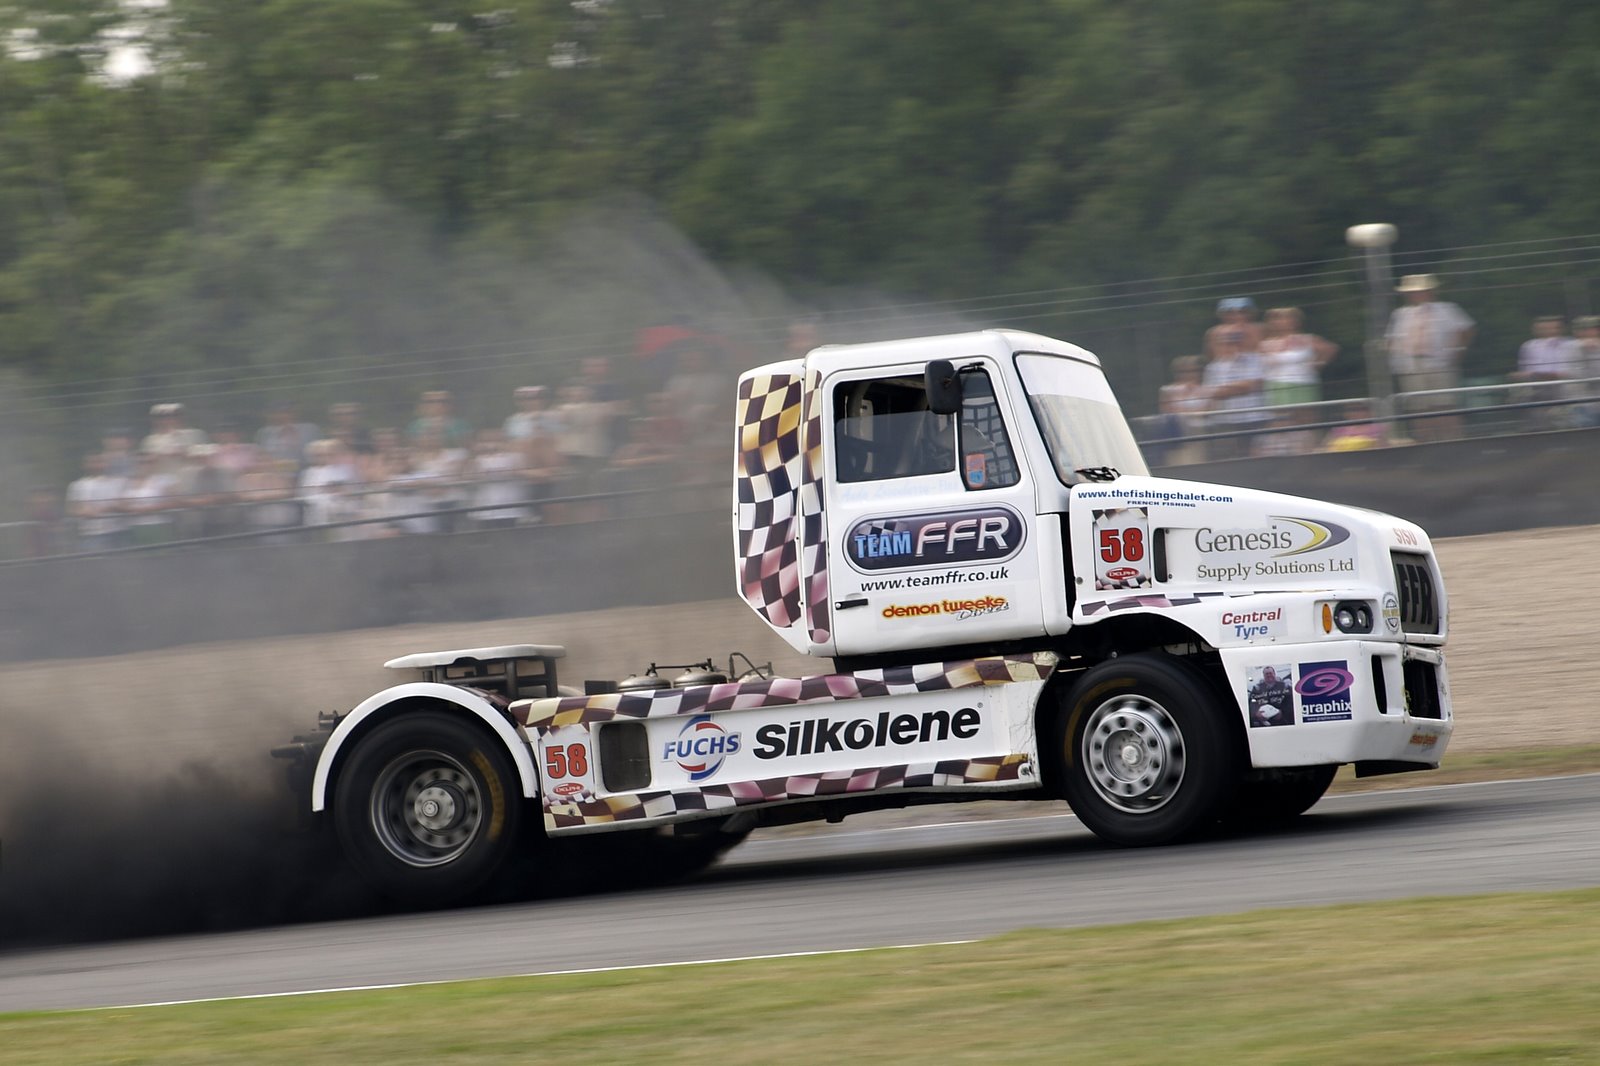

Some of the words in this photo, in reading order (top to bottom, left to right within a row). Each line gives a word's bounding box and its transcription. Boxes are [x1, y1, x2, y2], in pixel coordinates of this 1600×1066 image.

[1077, 489, 1233, 503] www.thefishingchalet.com
[854, 530, 912, 559] TEAM
[914, 516, 1010, 557] FFR
[1099, 527, 1144, 563] 58
[1195, 525, 1292, 553] Genesis
[860, 566, 1010, 592] www.teamffr.co.uk
[1107, 569, 1137, 578] DELPHI
[1197, 563, 1252, 582] Supply
[1255, 560, 1325, 575] Solutions
[1329, 558, 1354, 572] Ltd
[882, 605, 940, 618] demon
[941, 596, 1006, 612] tweeks
[1221, 607, 1282, 625] Central
[1234, 624, 1269, 640] Tyre
[1301, 699, 1352, 715] graphix
[752, 707, 981, 760] Silkolene
[663, 734, 739, 760] FUCHS
[545, 742, 588, 779] 58
